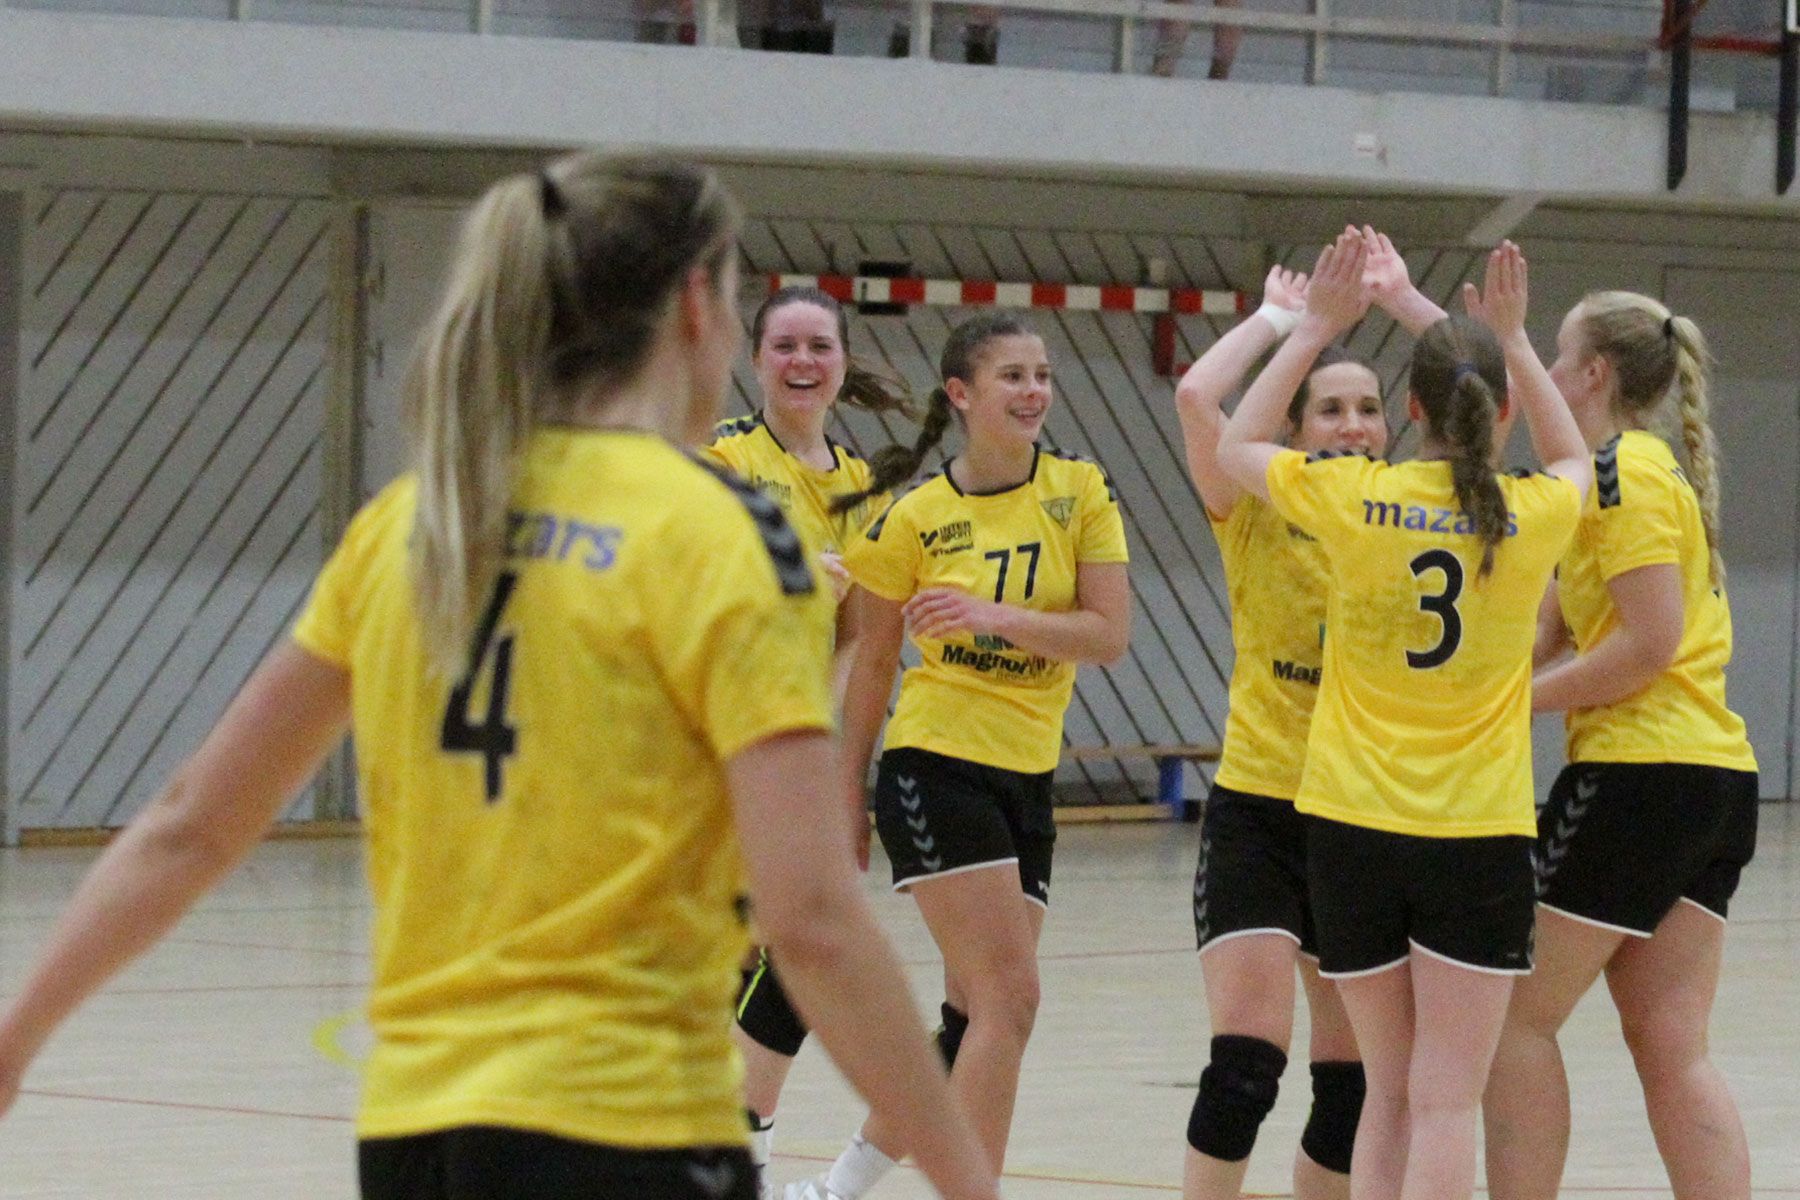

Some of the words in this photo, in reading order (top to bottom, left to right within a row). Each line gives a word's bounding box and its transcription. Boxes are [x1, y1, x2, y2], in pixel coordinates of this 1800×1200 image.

[1363, 498, 1518, 537] mazas
[984, 541, 1042, 604] 77
[1405, 548, 1464, 669] 3
[440, 570, 518, 804] 4
